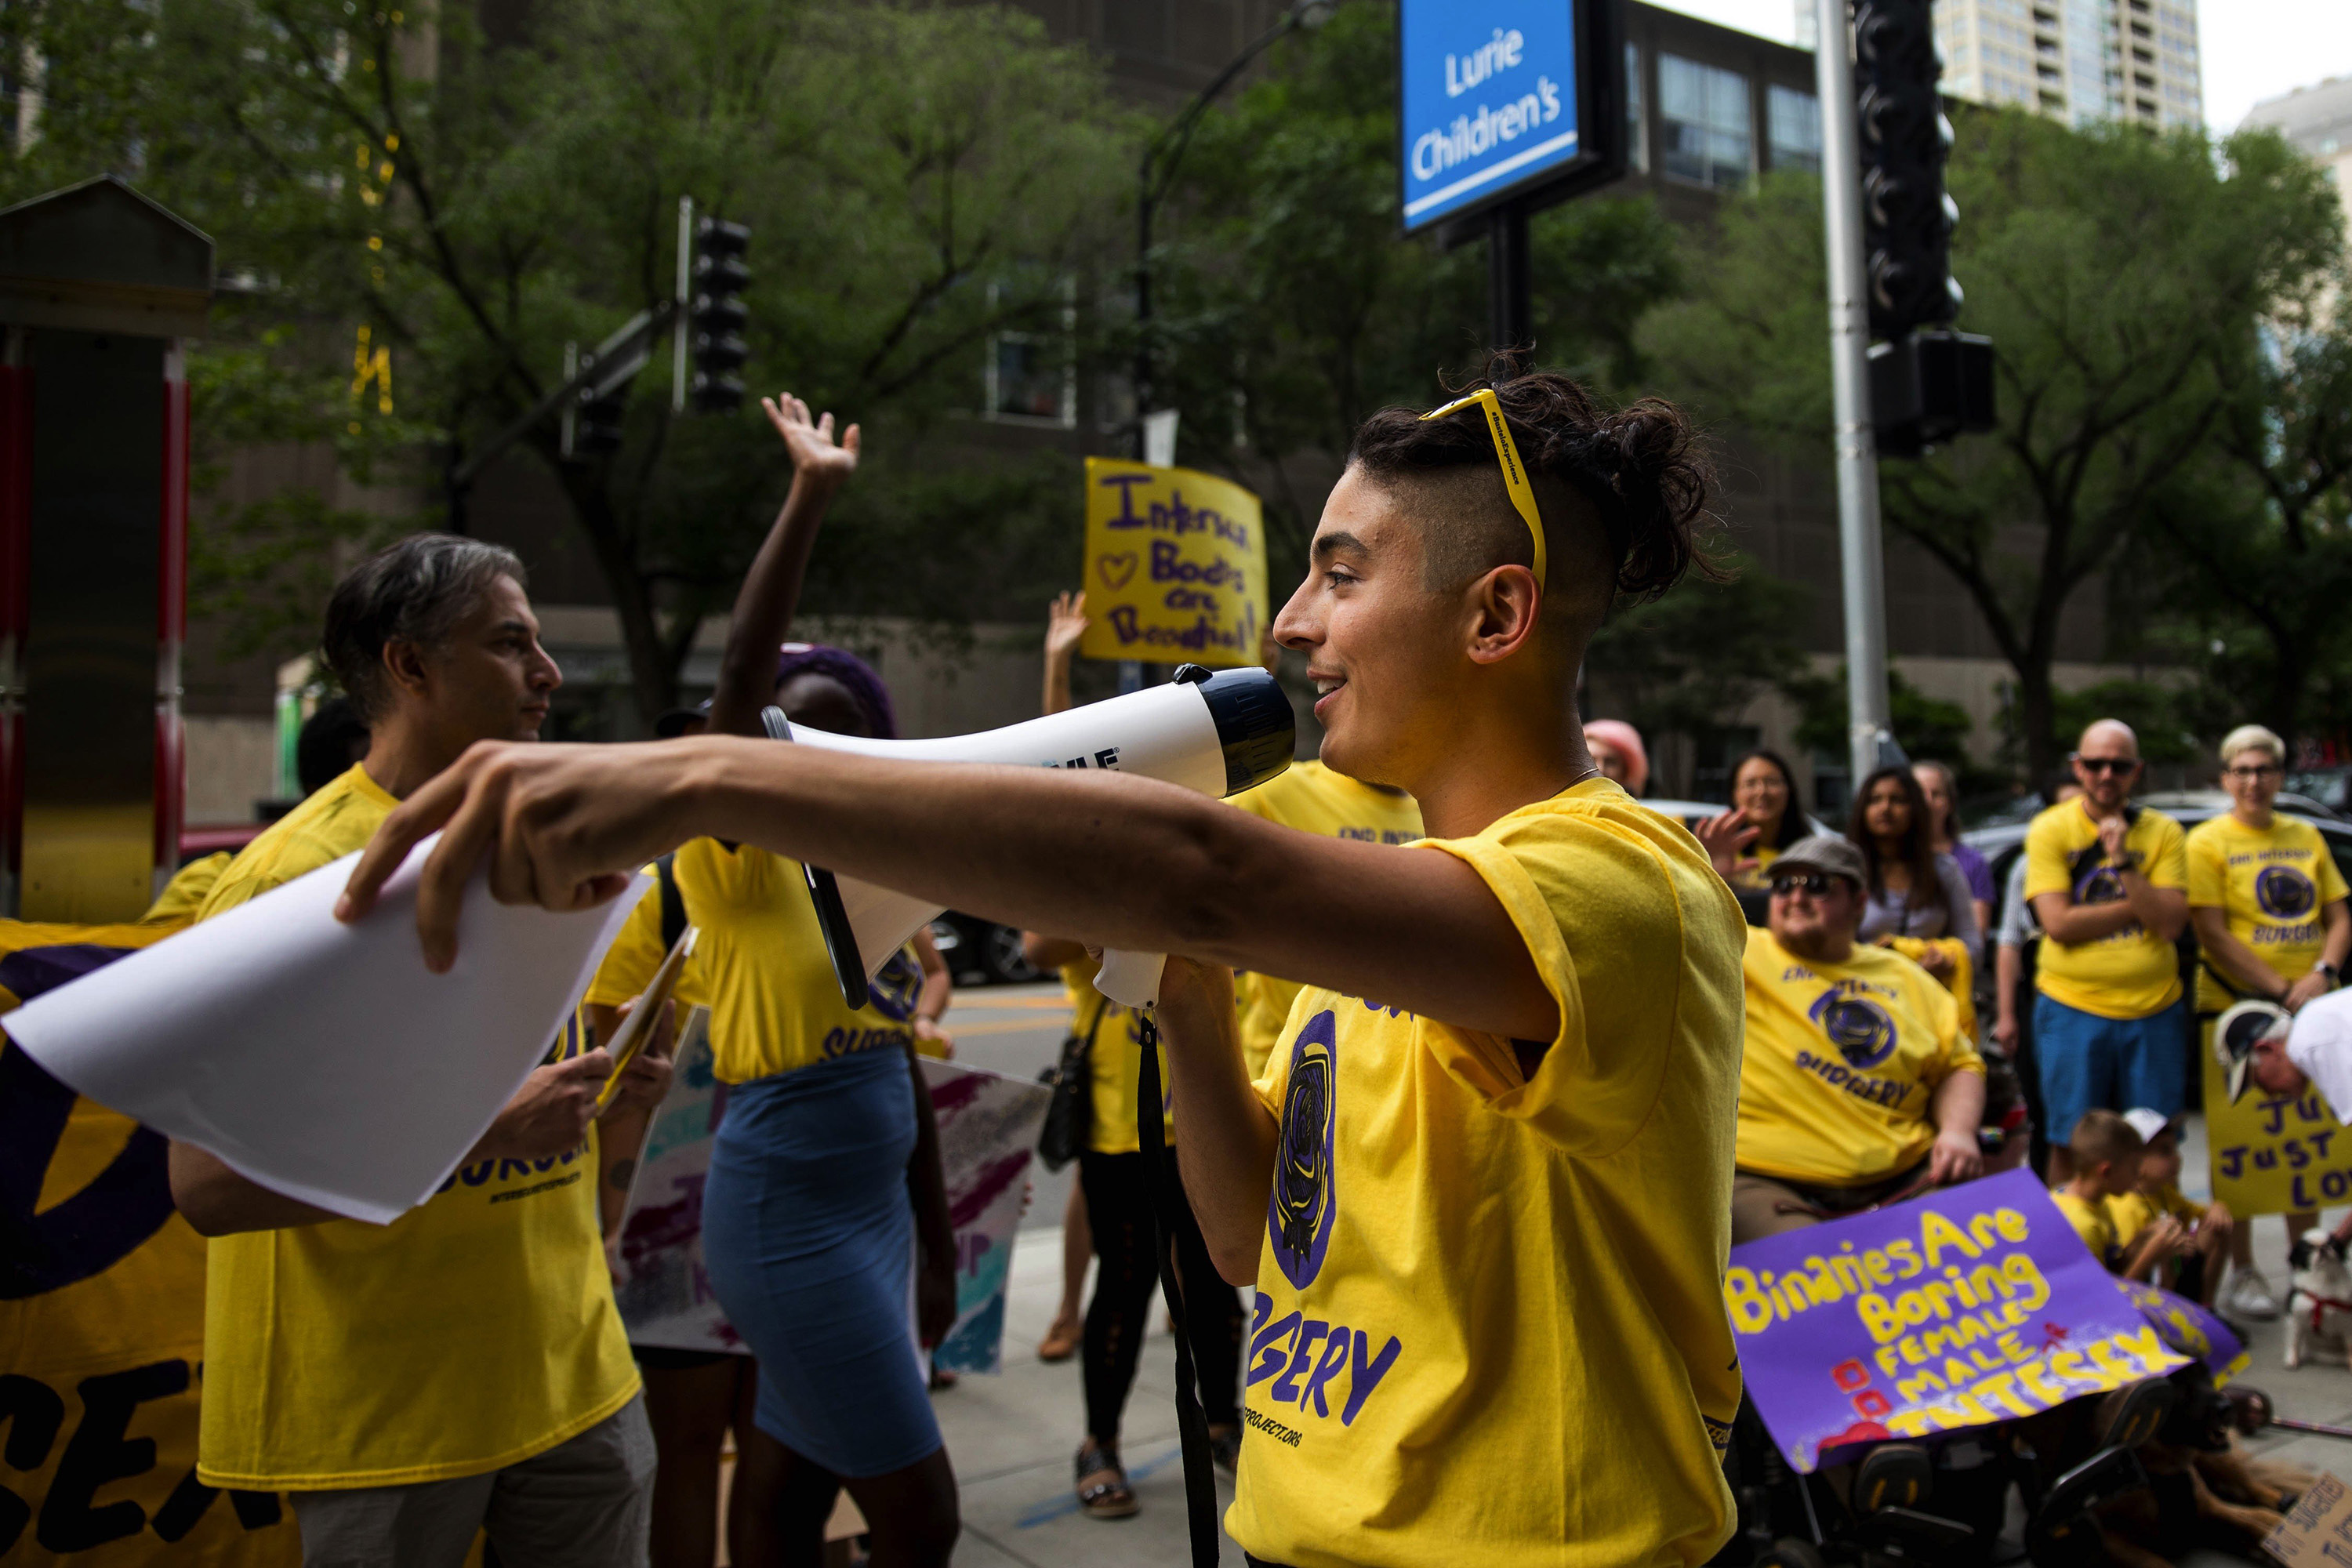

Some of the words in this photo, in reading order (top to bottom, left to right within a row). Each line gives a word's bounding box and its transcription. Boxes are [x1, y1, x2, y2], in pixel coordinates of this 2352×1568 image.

[1445, 27, 1523, 98] Lurie
[1411, 74, 1561, 181] Children's
[1491, 411, 1519, 485] #BusteloExperience
[2220, 1130, 2334, 1181] JUST
[2292, 1169, 2352, 1209] LO
[1723, 1240, 1923, 1334] Binaries
[1920, 1207, 2030, 1269] Are
[1856, 1253, 2051, 1344] Boring
[1873, 1299, 2031, 1378] FEMALE
[1896, 1331, 2038, 1403] MALE
